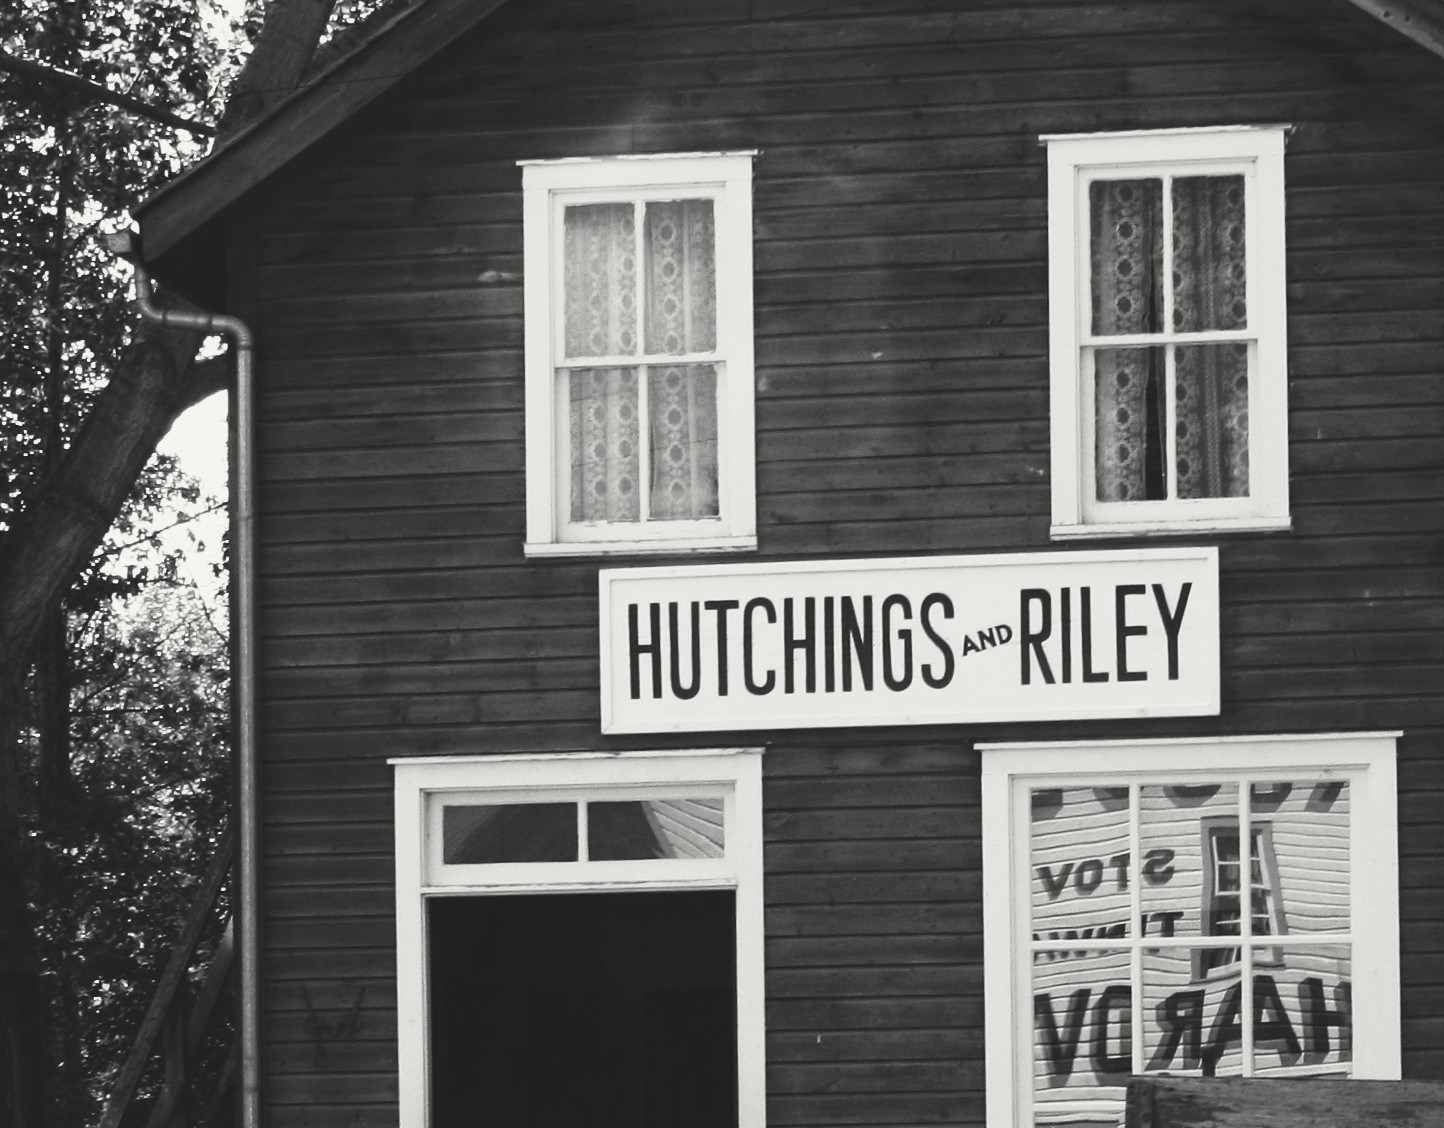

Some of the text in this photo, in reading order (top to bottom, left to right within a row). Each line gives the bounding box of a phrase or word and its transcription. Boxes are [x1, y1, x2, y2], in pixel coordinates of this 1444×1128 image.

[628, 582, 1193, 700] HUTCHINGS AND RILEY
